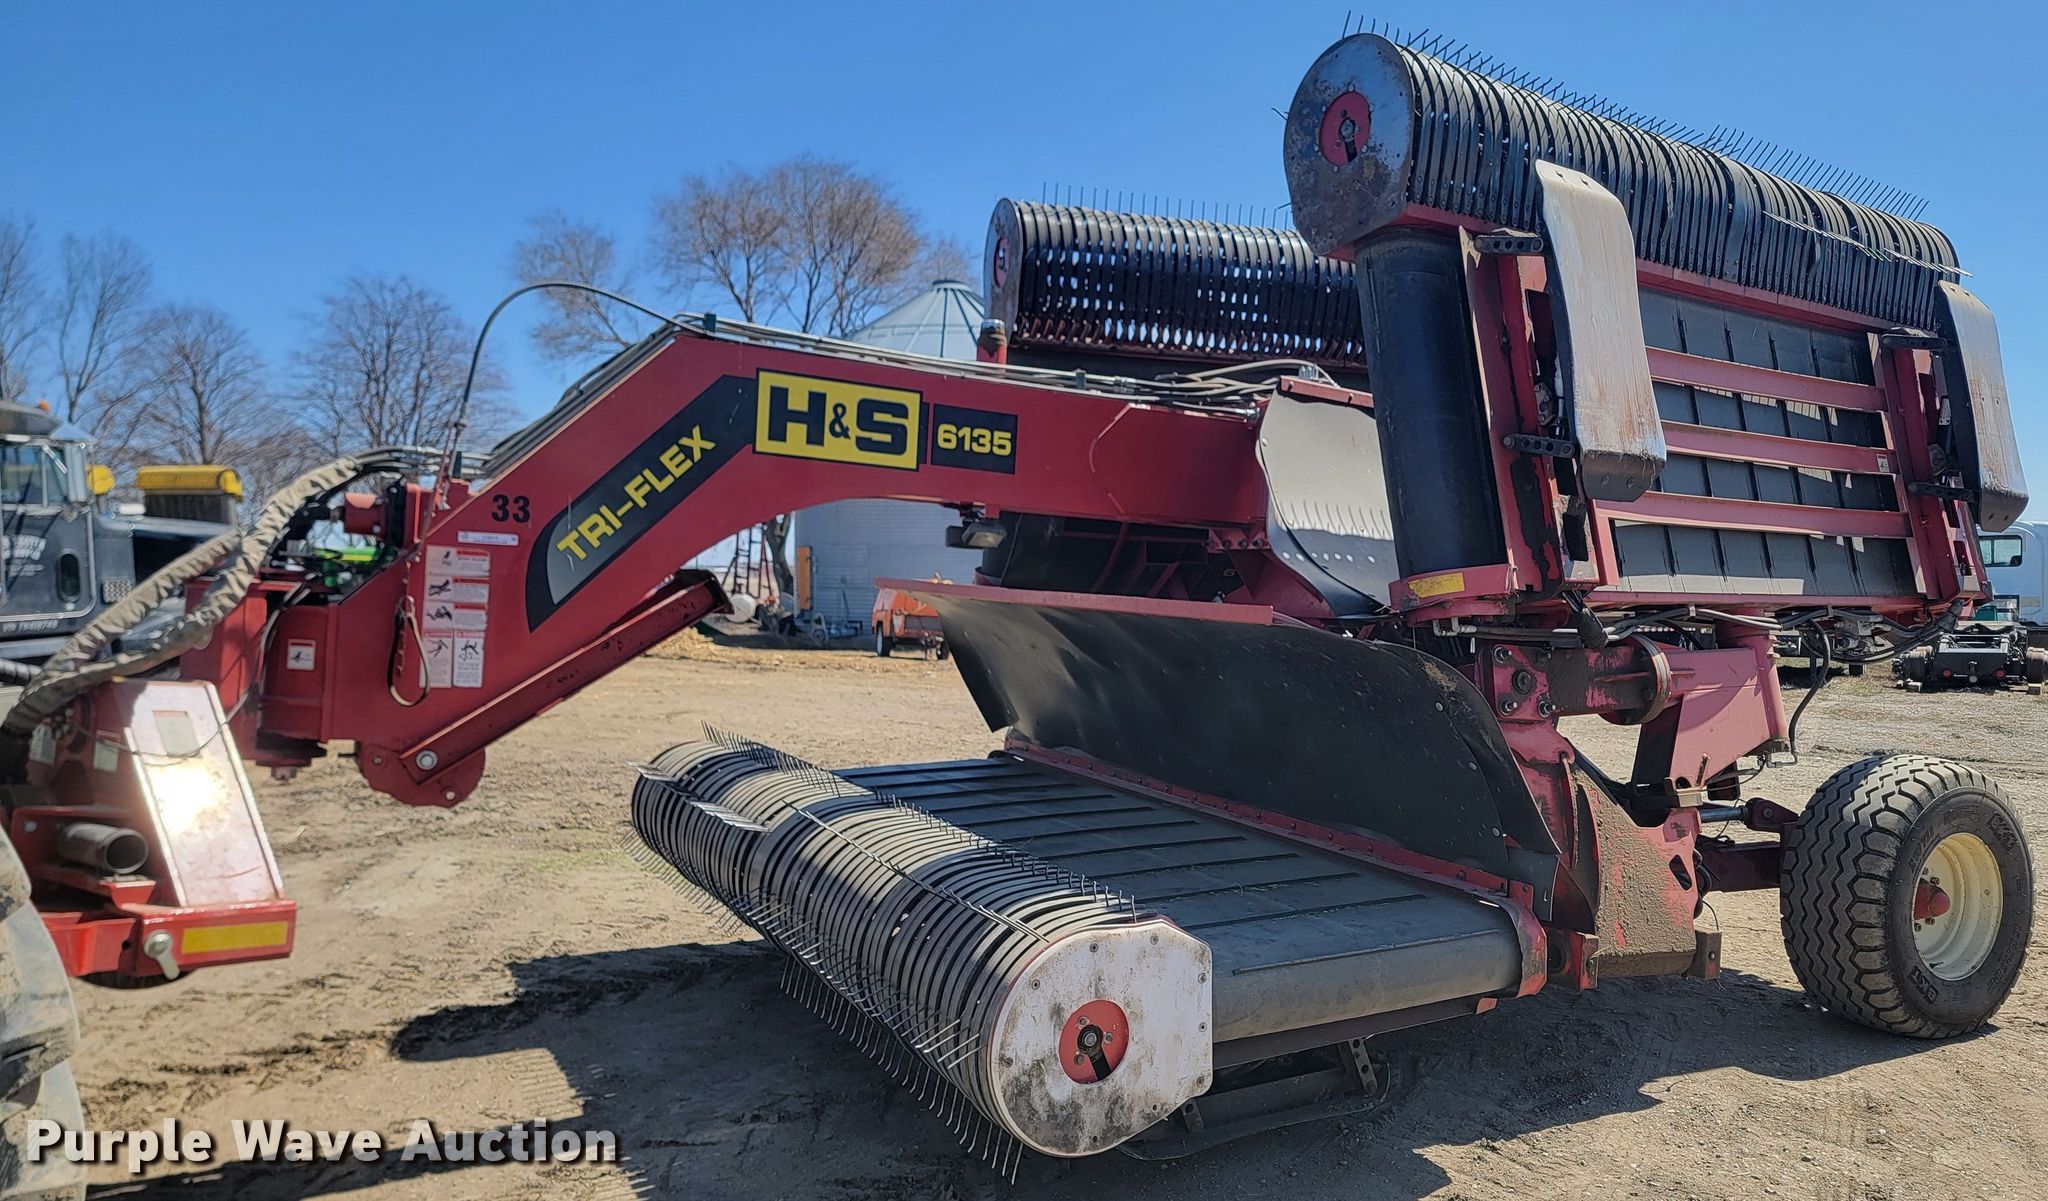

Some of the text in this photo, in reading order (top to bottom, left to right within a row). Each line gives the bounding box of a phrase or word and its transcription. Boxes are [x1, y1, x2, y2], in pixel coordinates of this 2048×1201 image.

[767, 385, 910, 456] H&S
[936, 422, 1013, 457] 6135
[491, 495, 530, 524] 33
[556, 425, 717, 562] TRI-FLEX
[1910, 966, 1937, 1003] BKT
